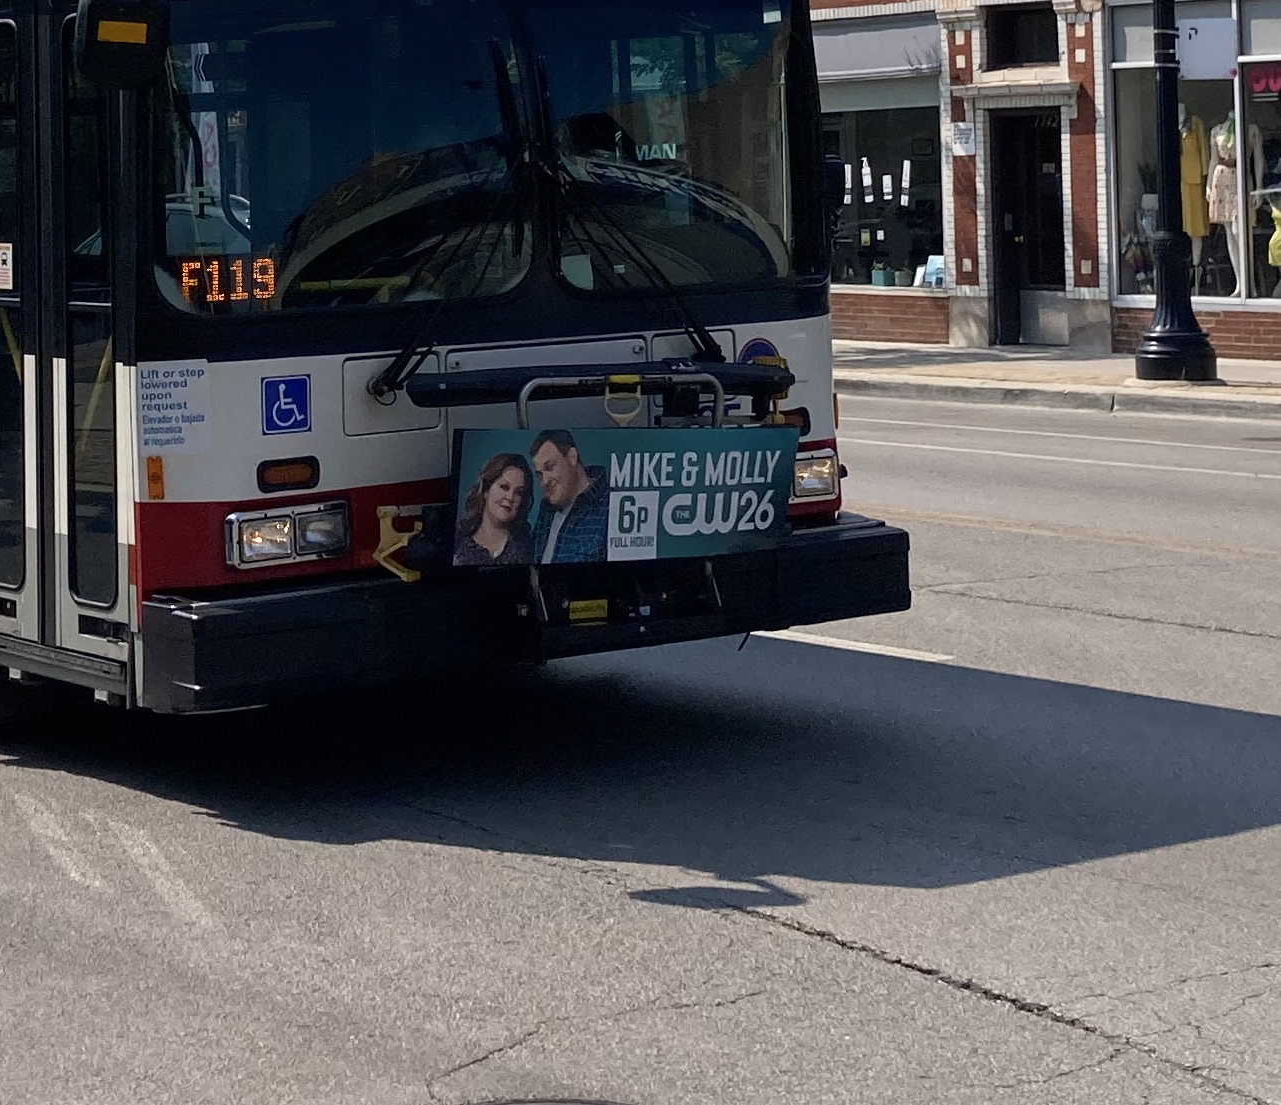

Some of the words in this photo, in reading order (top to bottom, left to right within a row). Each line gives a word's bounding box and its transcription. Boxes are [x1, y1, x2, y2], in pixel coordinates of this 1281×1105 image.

[181, 256, 276, 303] F119
[140, 369, 160, 380] Lift
[162, 370, 176, 379] or
[140, 378, 188, 390] lowered
[141, 392, 173, 403] upon
[141, 400, 188, 413] request
[609, 452, 676, 488] MIKE
[680, 451, 699, 487] &
[704, 449, 782, 486] MOLLY
[674, 509, 692, 519] THE
[609, 536, 629, 548] FULL
[630, 536, 655, 548] HOUR!
